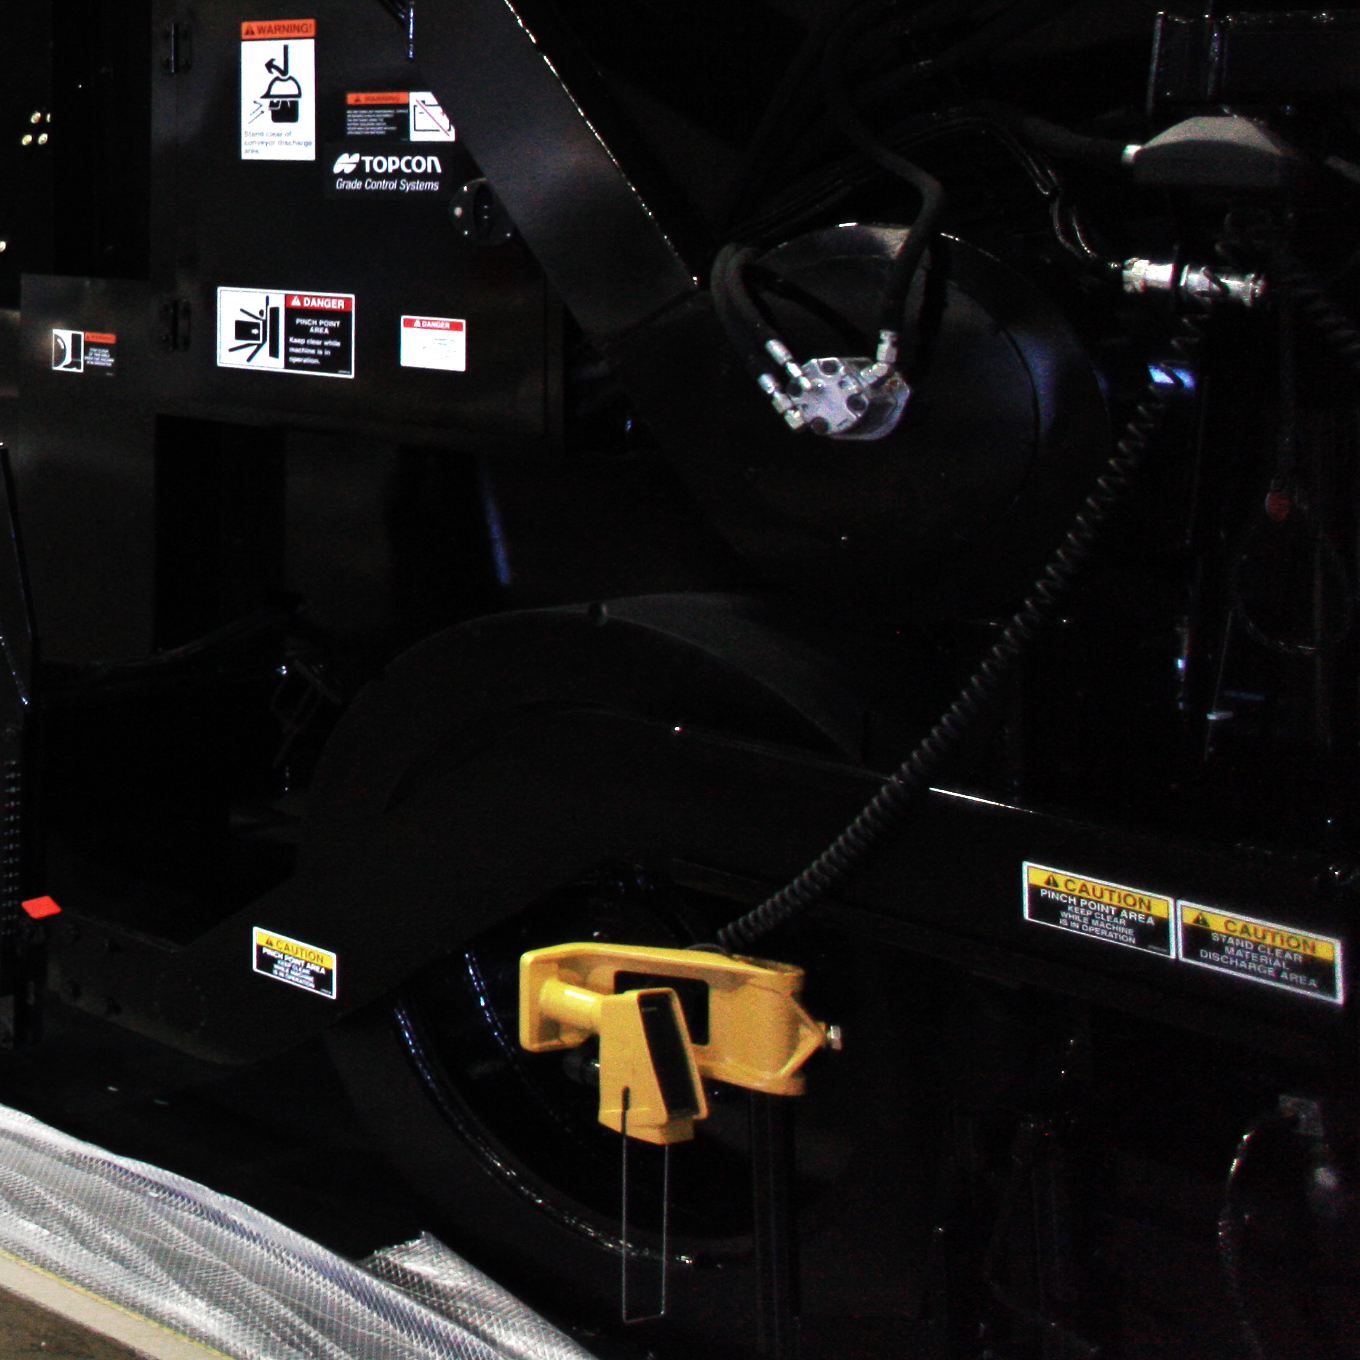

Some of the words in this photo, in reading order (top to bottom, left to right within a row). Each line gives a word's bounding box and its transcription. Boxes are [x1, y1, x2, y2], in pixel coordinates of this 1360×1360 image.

[257, 22, 313, 35] WARNING!
[361, 155, 442, 173] TOPCON
[336, 178, 362, 191] Grade
[365, 178, 398, 191] Control
[399, 178, 440, 193] Systems
[303, 297, 345, 310] DANGER
[295, 318, 317, 327] PINCH
[319, 319, 341, 328] POINT
[309, 326, 329, 334] AREA
[421, 320, 451, 329] DANGER
[289, 336, 305, 346] Keep
[307, 337, 322, 346] clear
[323, 338, 341, 348] while
[1064, 878, 1152, 912] CAUTION
[1040, 888, 1077, 906] PINCH
[1080, 898, 1118, 915] POINT
[1120, 907, 1156, 926] AREA
[1067, 904, 1092, 917] KEEP
[1094, 911, 1126, 926] CLEAR
[1059, 917, 1068, 926] IS
[1070, 920, 1079, 929] IN
[1081, 923, 1136, 944] OPERATION
[1060, 910, 1090, 925] WHILE
[1091, 917, 1135, 936] MACHINE
[1211, 931, 1254, 950] STAND
[1257, 943, 1303, 964] CLEAR
[1223, 918, 1317, 954] CAUTION
[275, 940, 324, 964] CAUTION
[1224, 945, 1290, 971] MATERIAL
[1199, 948, 1276, 977] DISCHARGE
[1280, 969, 1318, 988] AREA
